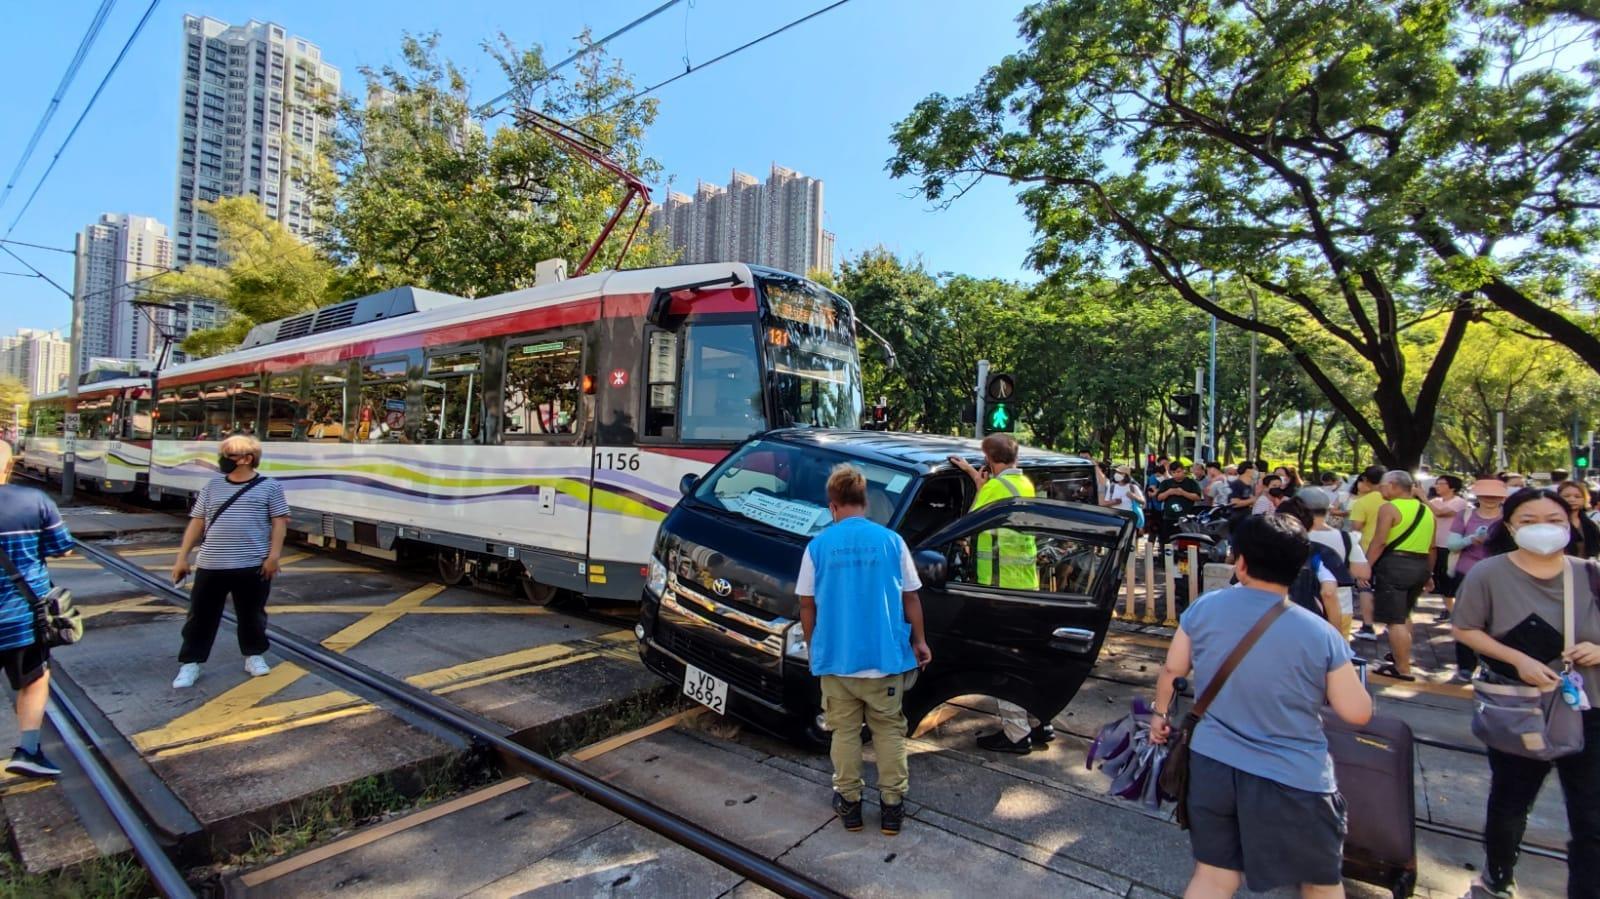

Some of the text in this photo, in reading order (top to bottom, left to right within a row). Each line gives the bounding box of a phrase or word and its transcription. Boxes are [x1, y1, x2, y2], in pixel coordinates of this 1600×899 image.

[595, 452, 640, 471] 1156
[698, 671, 715, 691] VD
[686, 681, 723, 712] 3692
